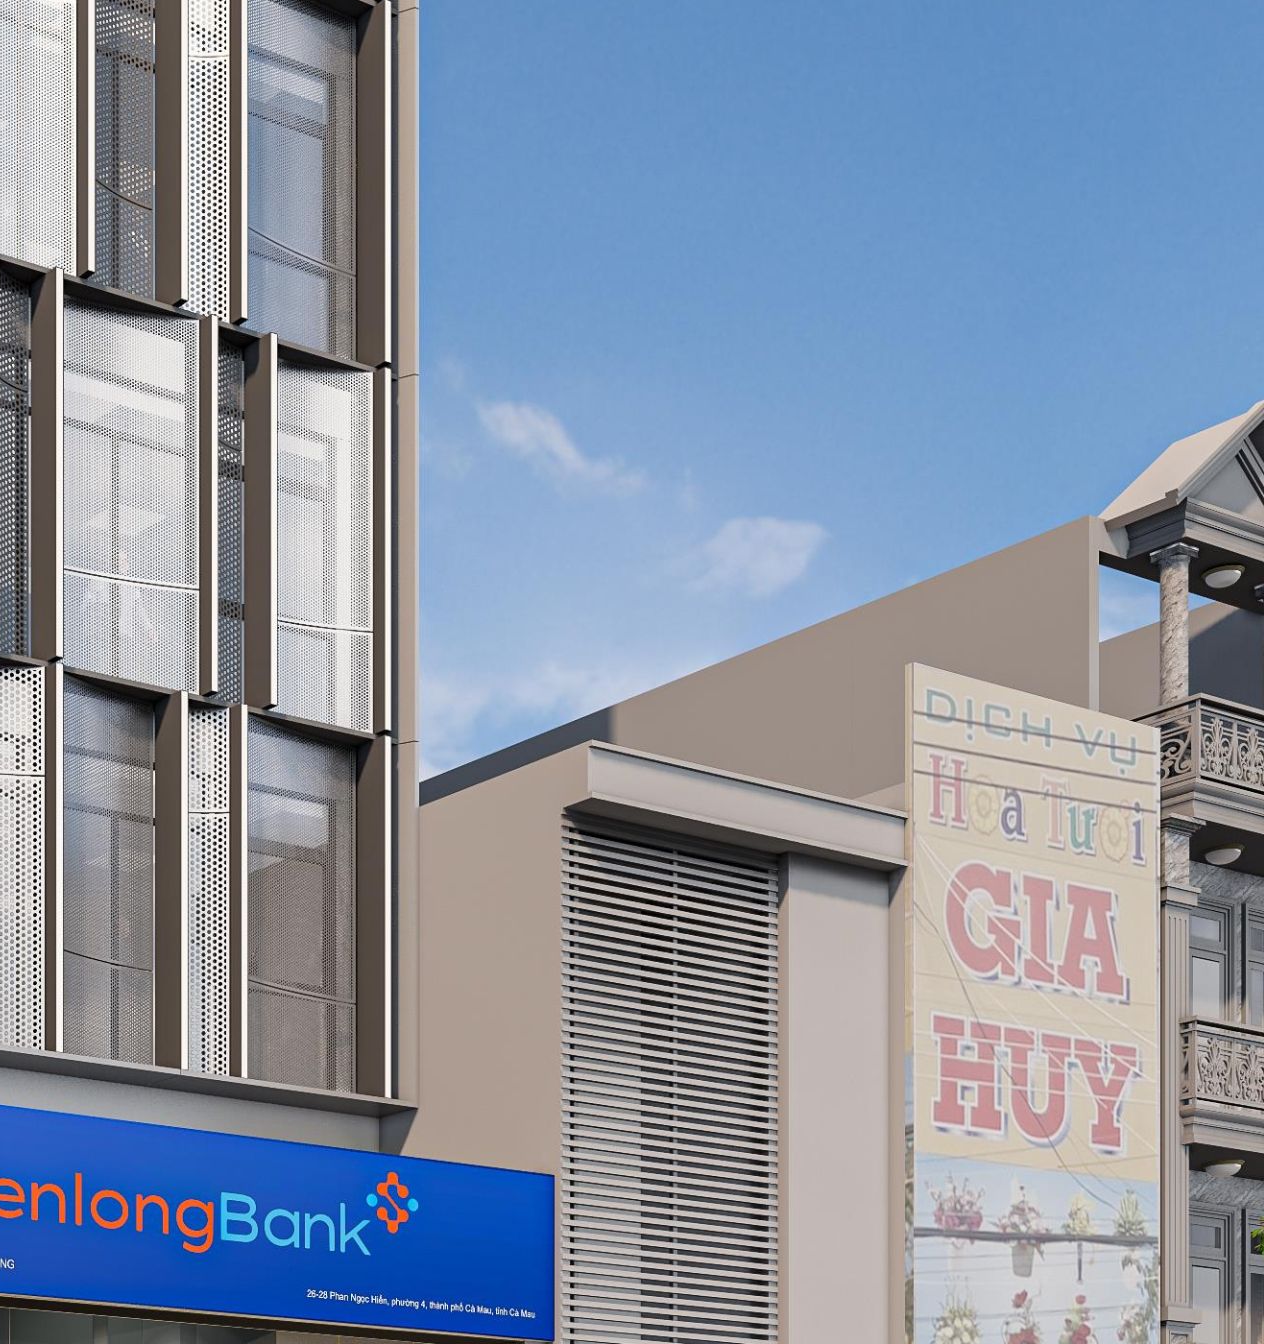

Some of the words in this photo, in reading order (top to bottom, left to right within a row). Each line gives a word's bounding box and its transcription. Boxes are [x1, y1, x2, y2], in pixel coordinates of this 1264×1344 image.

[926, 689, 1051, 748] DỊCH
[1075, 722, 1137, 775] VỤ
[945, 862, 1130, 1003] GIA
[932, 1014, 1138, 1153] HUY
[330, 1291, 348, 1302] Phan
[351, 1293, 369, 1305] Ngọc
